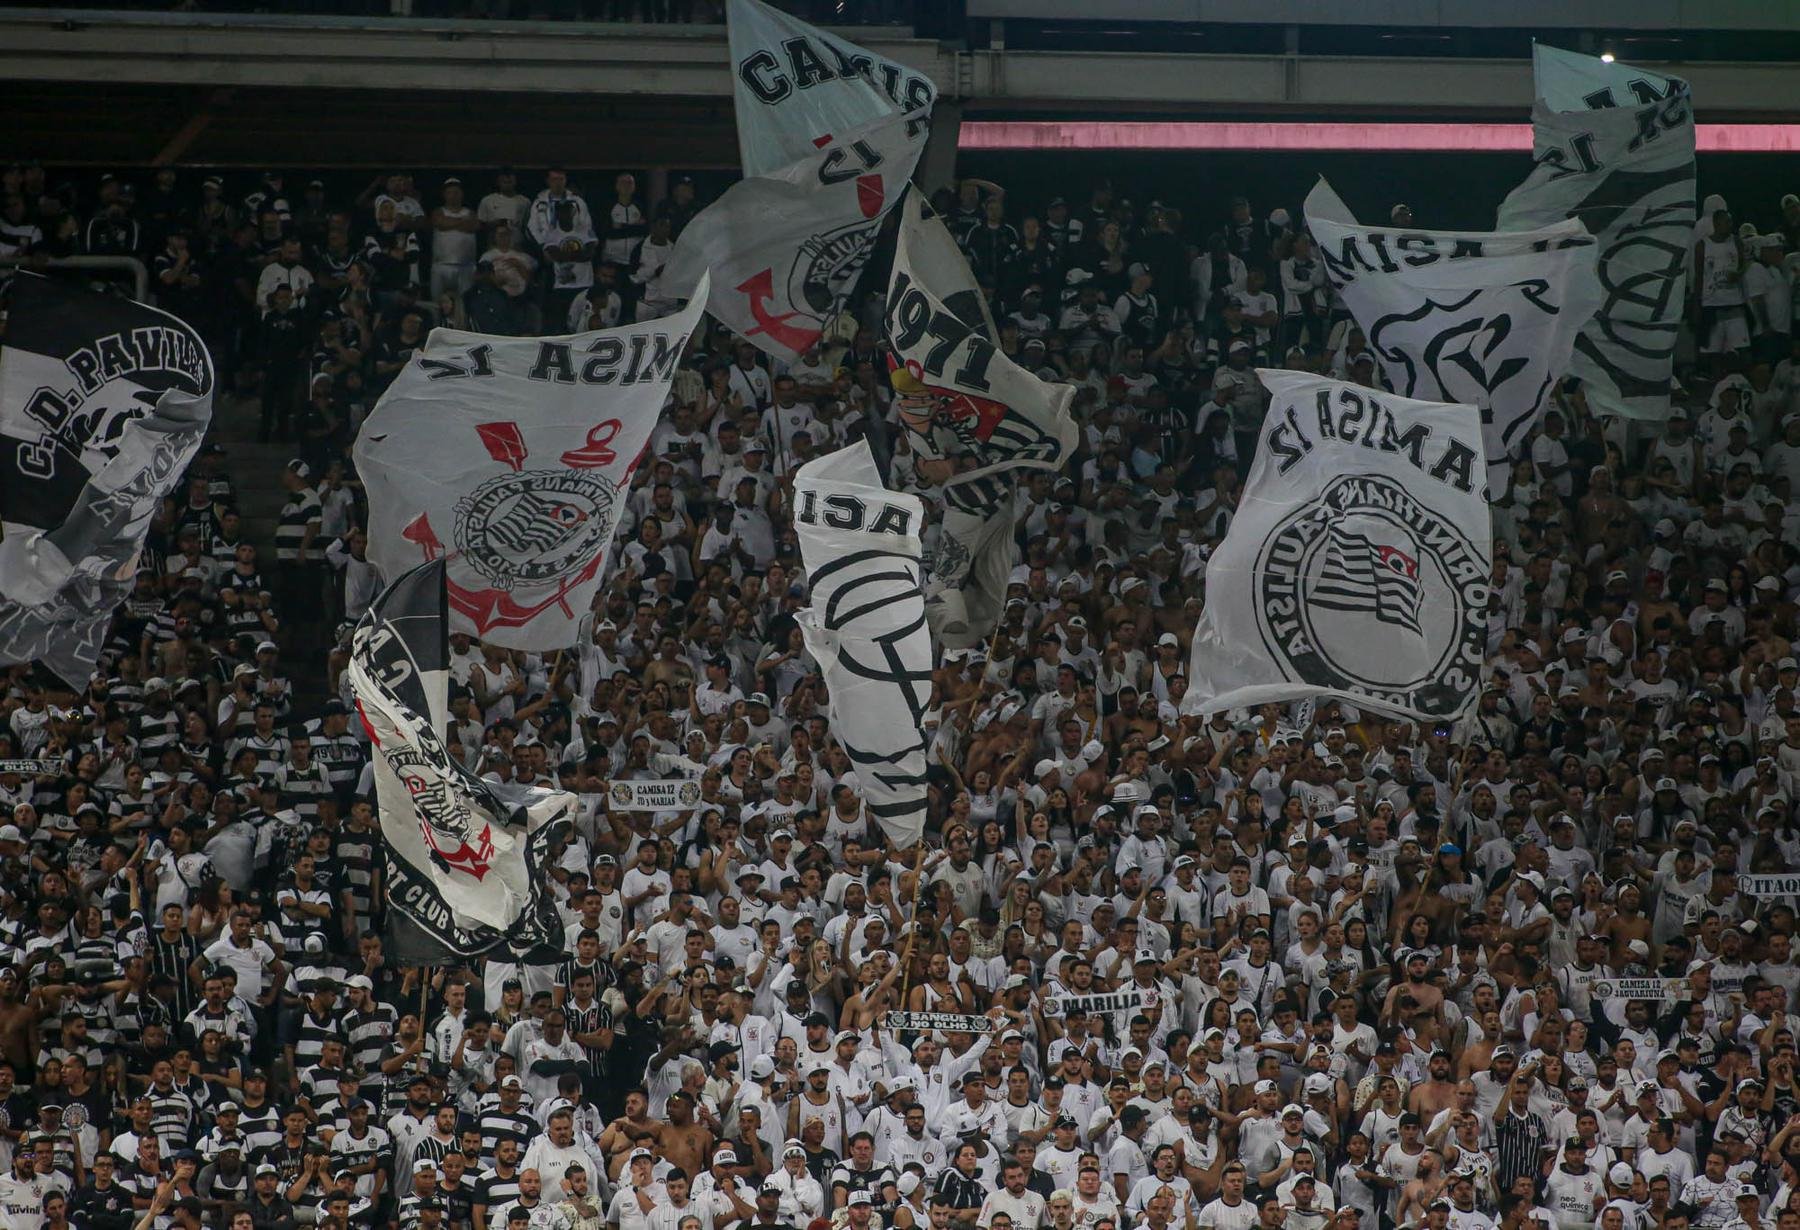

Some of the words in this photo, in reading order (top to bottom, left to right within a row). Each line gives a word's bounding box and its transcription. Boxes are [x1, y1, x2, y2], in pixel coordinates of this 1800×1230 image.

[884, 271, 997, 394] 1971
[637, 785, 667, 795] CAMISA
[667, 784, 675, 794] 12
[1755, 879, 1800, 893] ITAQ
[405, 884, 450, 933] CLUB
[1619, 980, 1651, 989] CAMISA
[1062, 992, 1142, 1013] MARILIA
[911, 1013, 968, 1022] SANGUE
[911, 1020, 930, 1028] NO
[934, 1021, 968, 1029] OLHO
